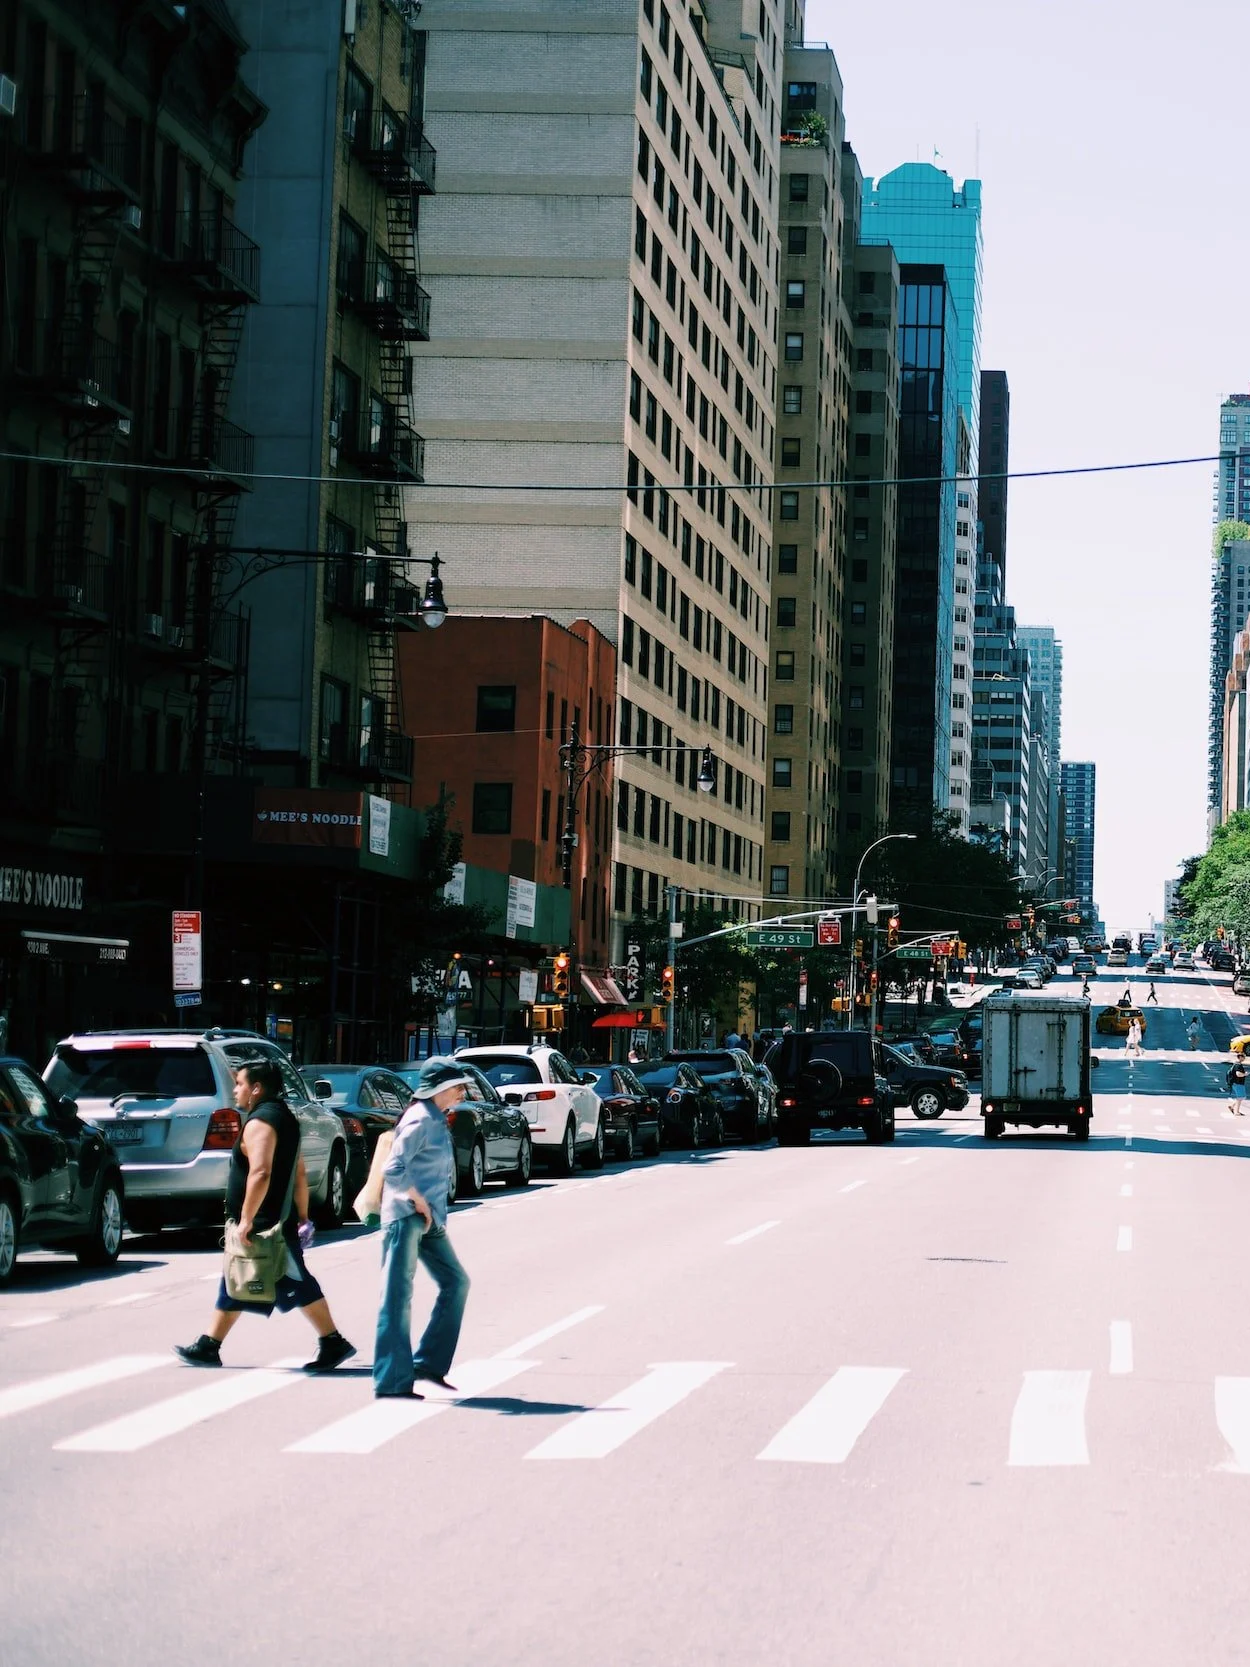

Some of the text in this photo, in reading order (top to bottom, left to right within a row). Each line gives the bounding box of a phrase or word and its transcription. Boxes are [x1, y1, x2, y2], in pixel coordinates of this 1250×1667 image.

[269, 811, 308, 823] MEE'S
[34, 871, 83, 910] NOODLE
[759, 935, 801, 944] E 49 St
